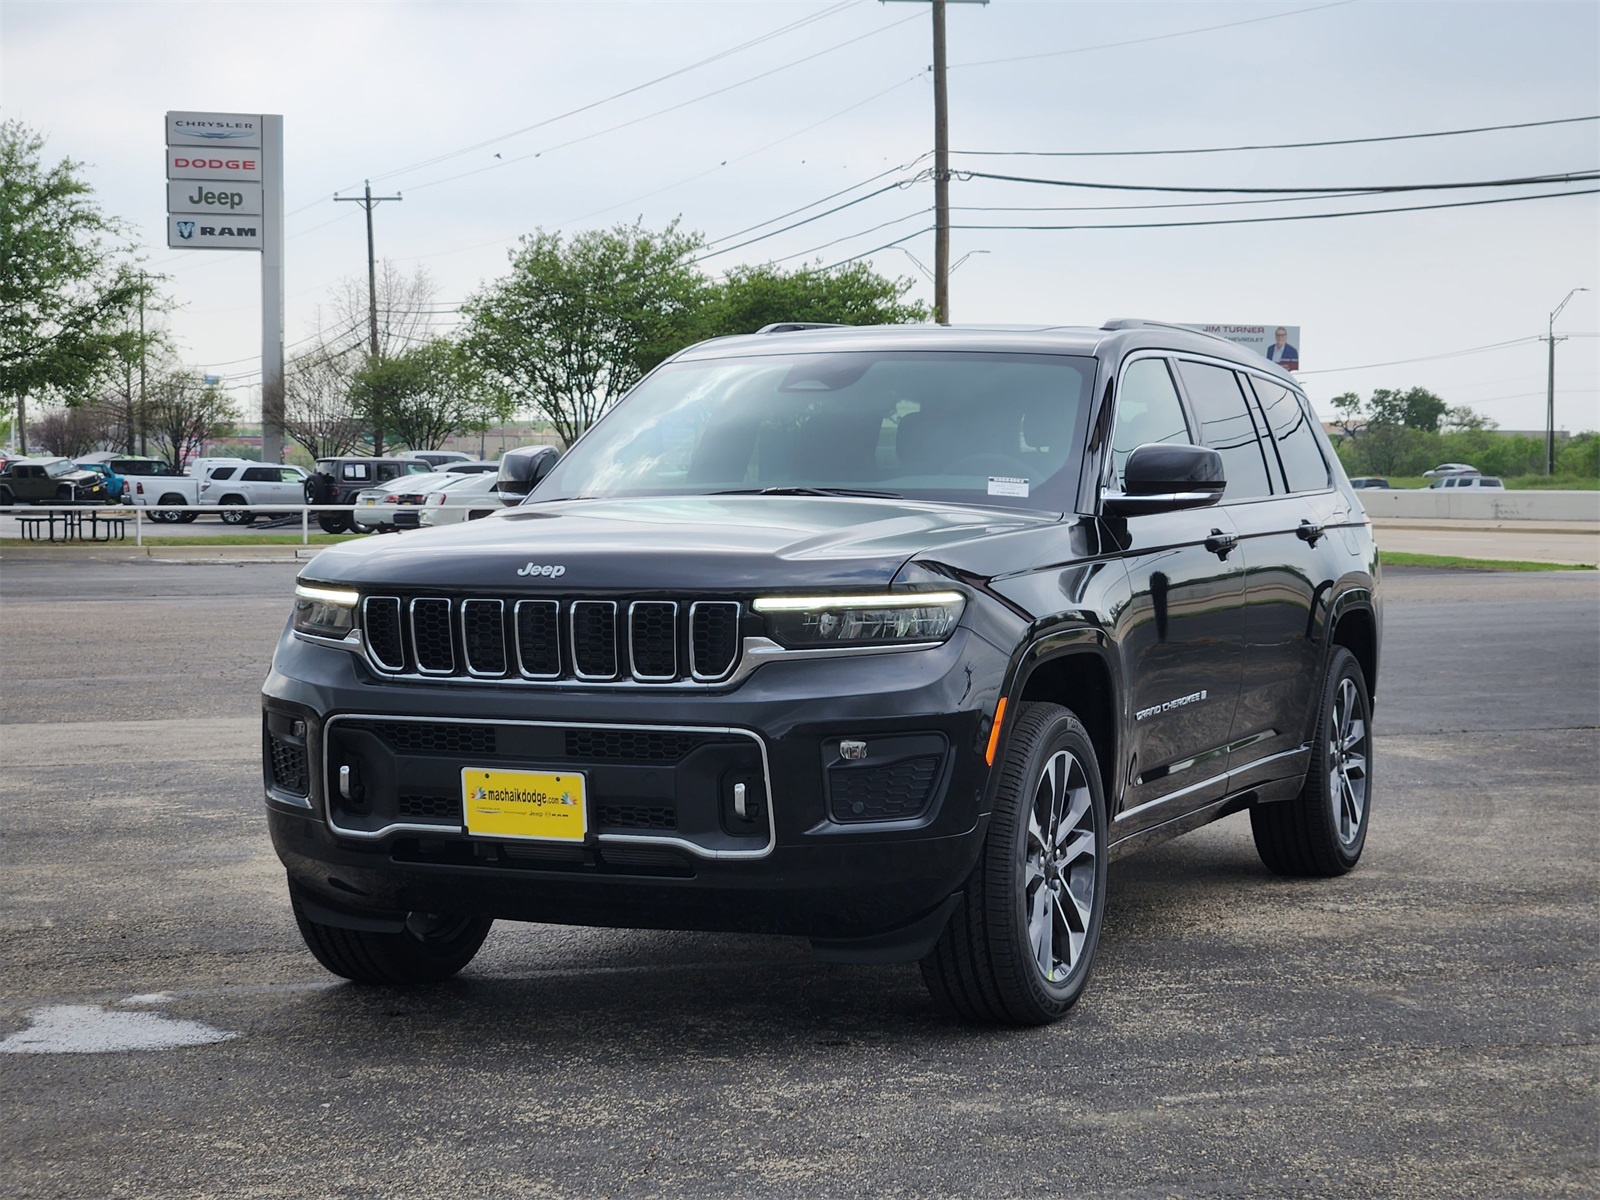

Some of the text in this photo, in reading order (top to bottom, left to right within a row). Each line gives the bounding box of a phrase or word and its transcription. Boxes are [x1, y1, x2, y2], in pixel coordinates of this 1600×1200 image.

[175, 120, 253, 129] CHRYSLER
[174, 158, 256, 170] DODGE
[188, 186, 244, 209] Jeep
[200, 226, 257, 237] RAM
[1202, 325, 1265, 334] JIM TURNER
[517, 562, 566, 579] Jeep
[1136, 704, 1161, 721] GRAND
[1161, 692, 1200, 712] CHEROKEE
[488, 787, 560, 807] machaikdodge.com
